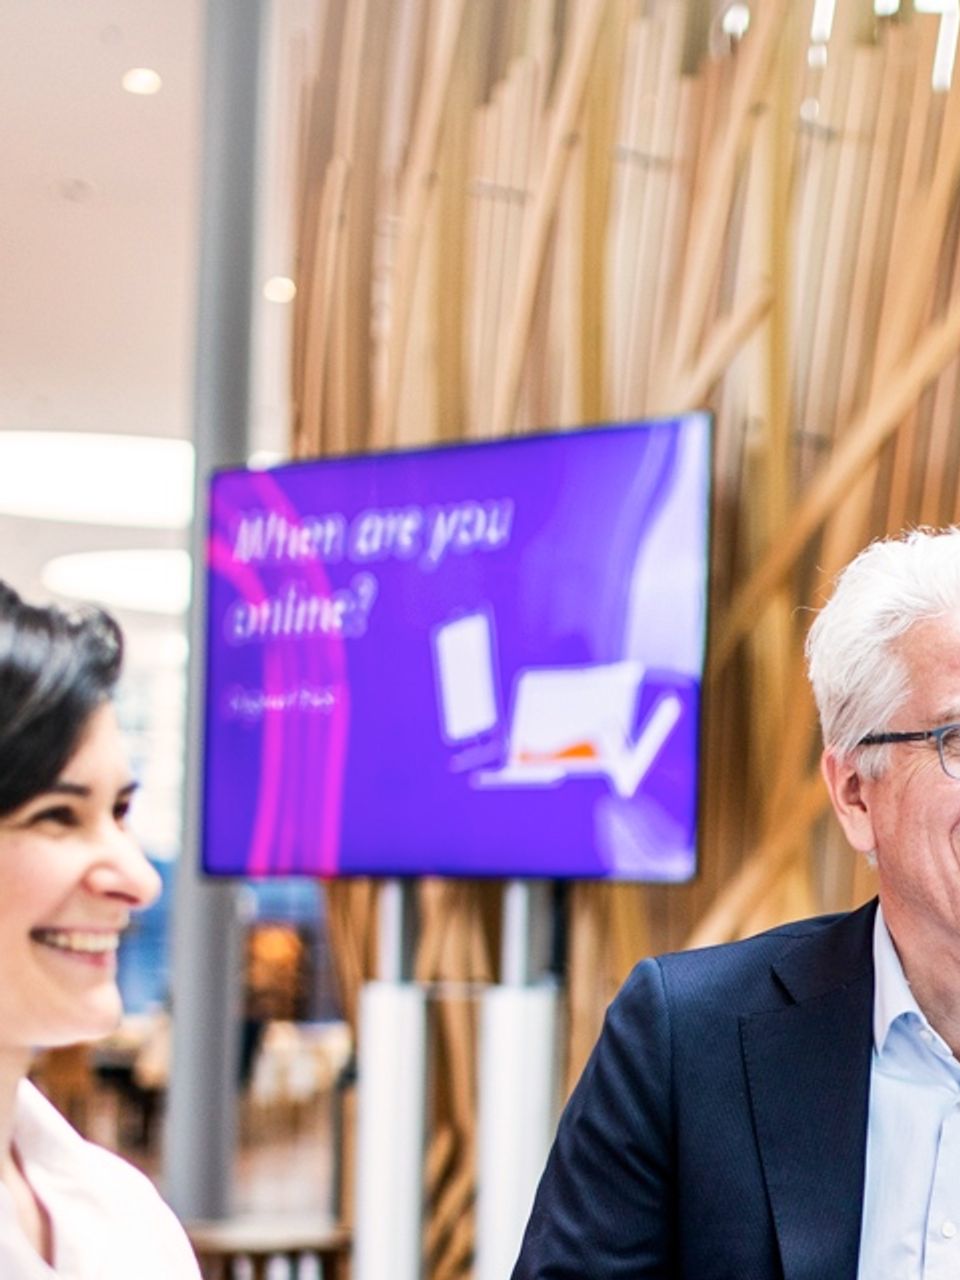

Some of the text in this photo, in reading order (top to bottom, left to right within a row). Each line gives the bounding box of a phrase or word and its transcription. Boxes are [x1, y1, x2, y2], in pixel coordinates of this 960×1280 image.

[230, 499, 514, 571] When are you
[226, 572, 377, 643] online?
